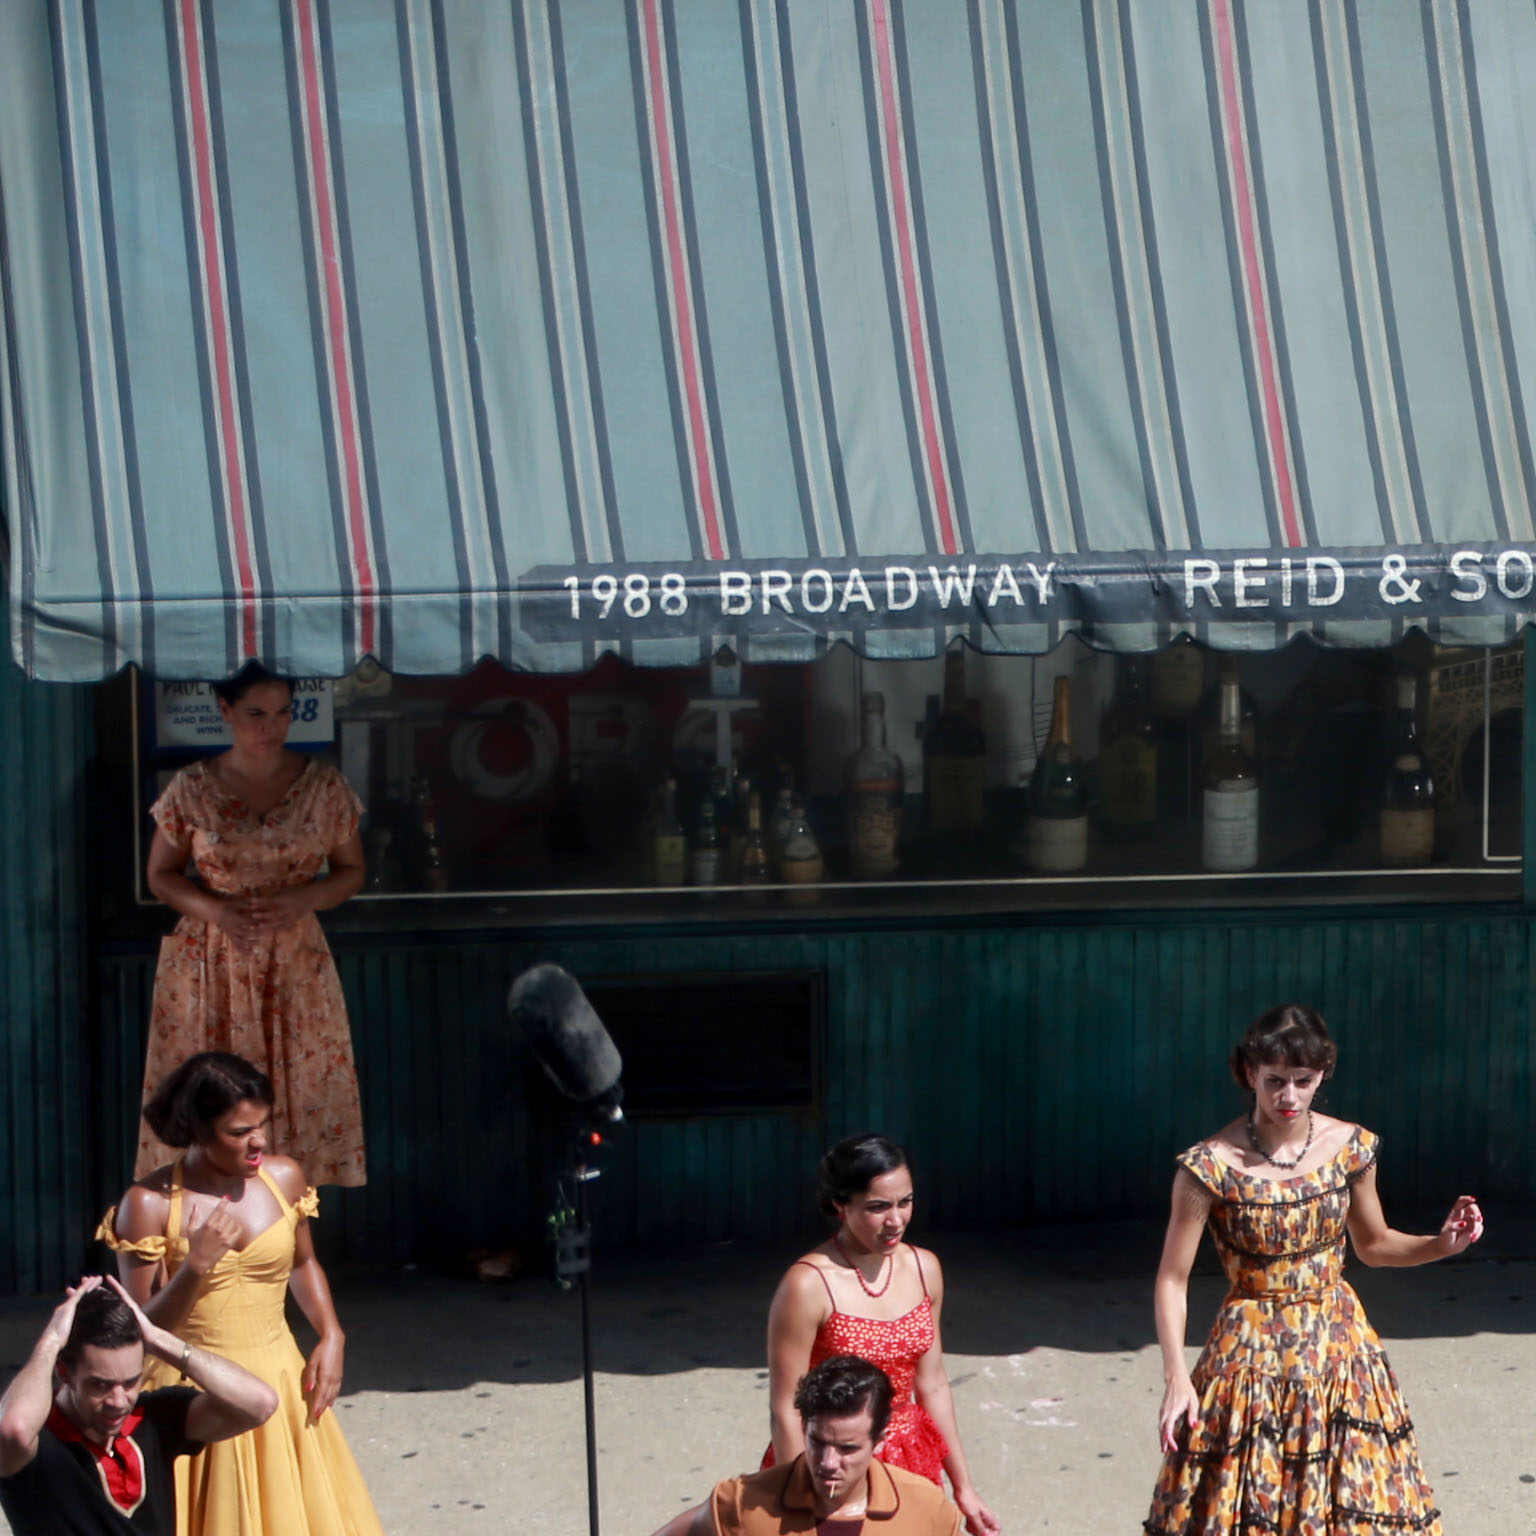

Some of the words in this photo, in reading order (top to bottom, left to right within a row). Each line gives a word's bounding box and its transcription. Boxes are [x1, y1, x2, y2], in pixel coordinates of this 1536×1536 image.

[564, 572, 689, 622] 1988
[720, 561, 1057, 617] BROADWAY
[1182, 556, 1347, 609] REID
[1379, 552, 1422, 606] &
